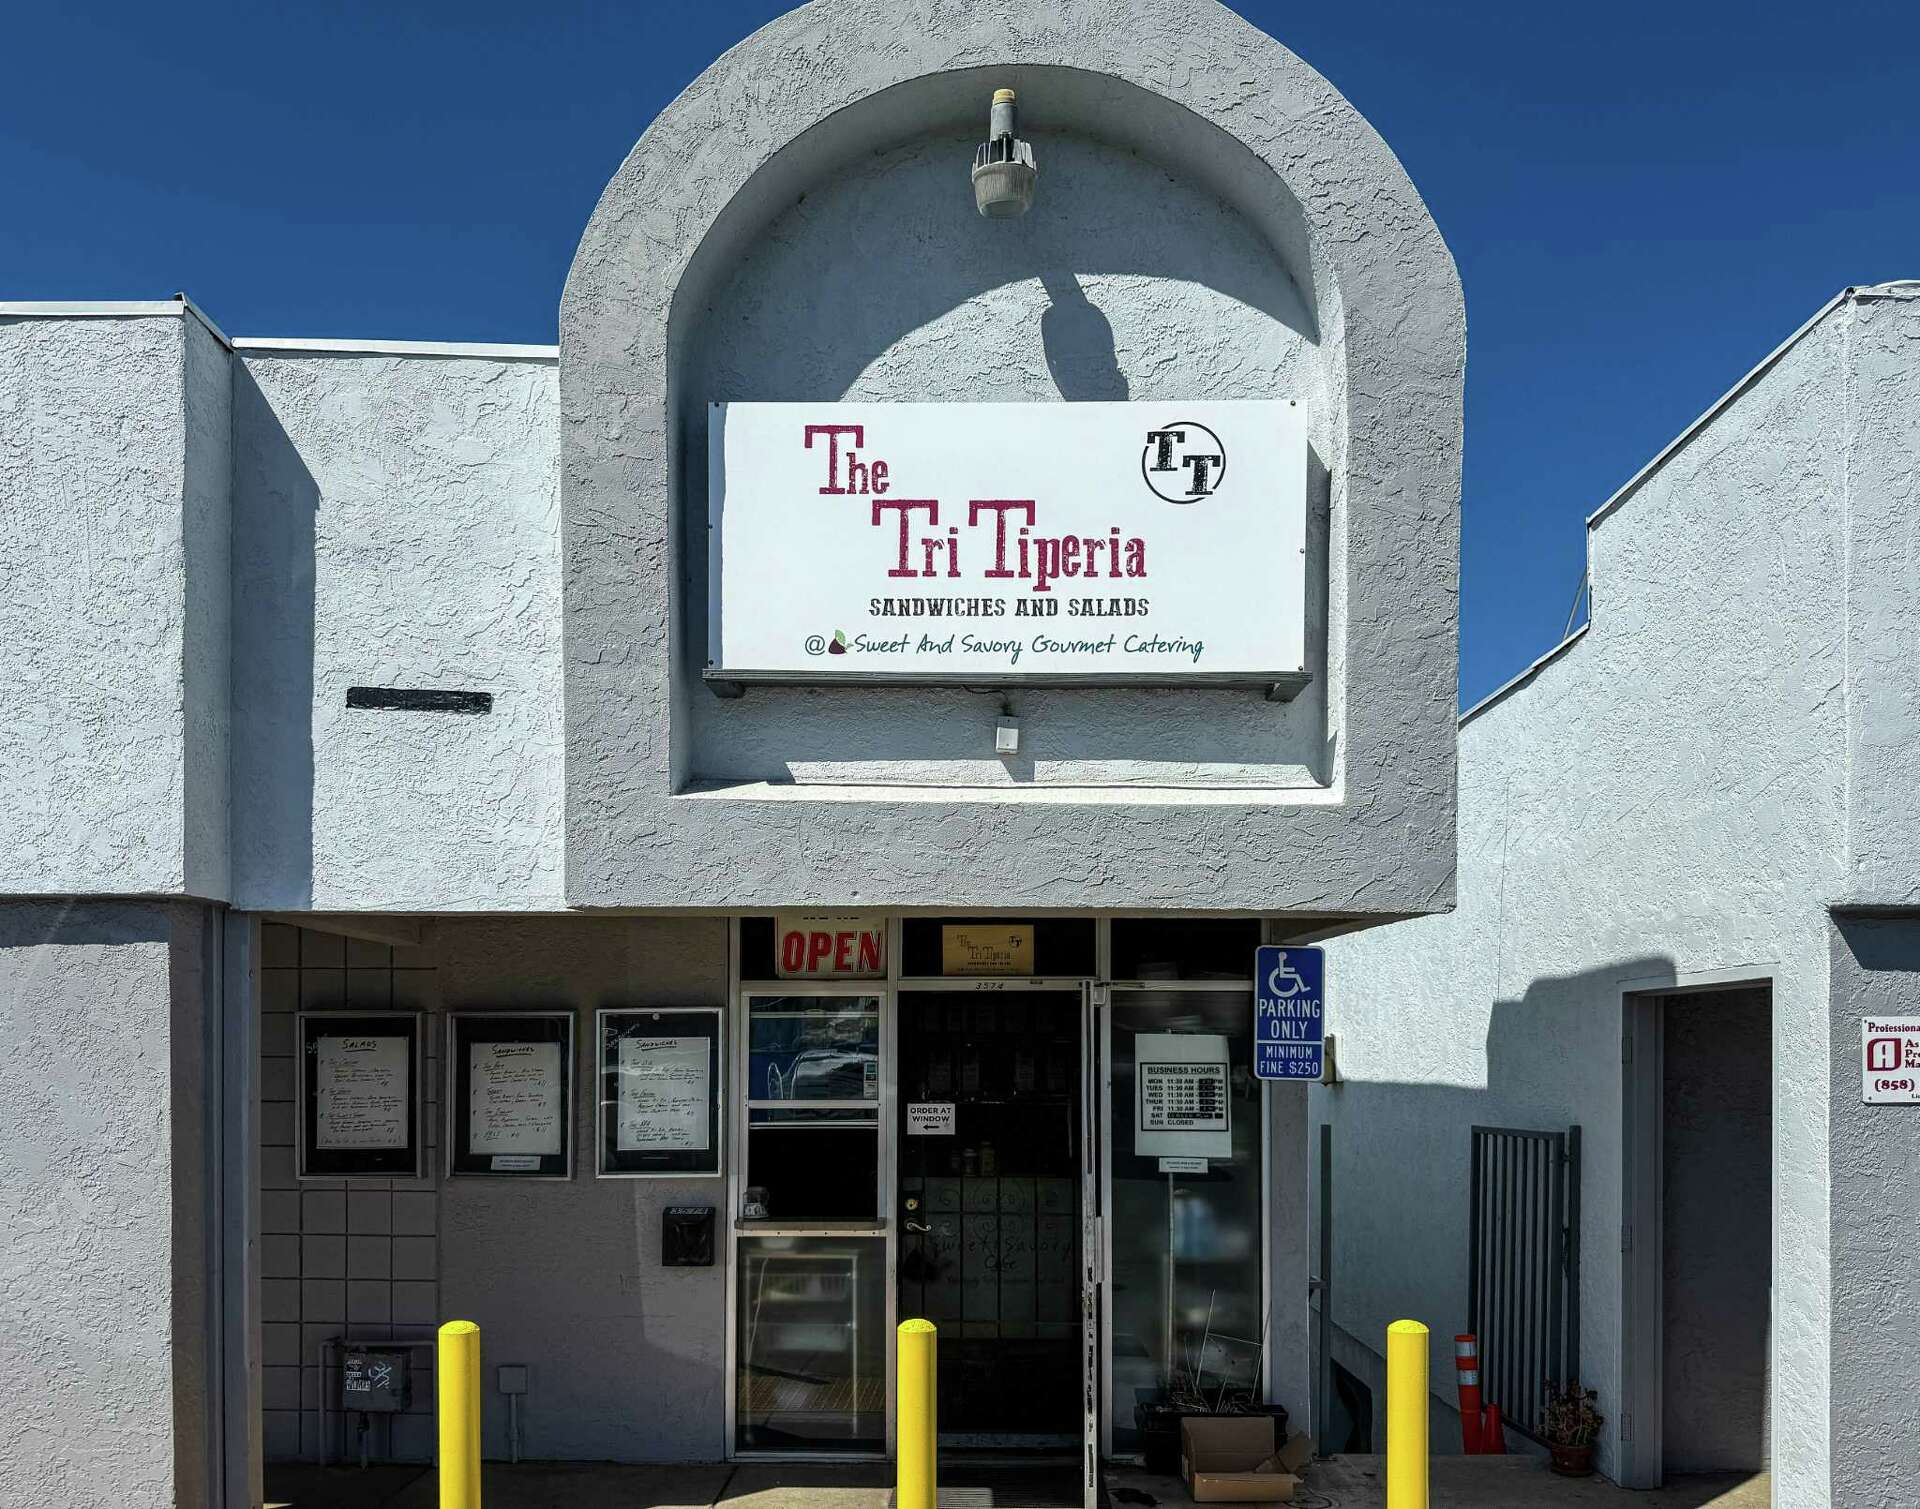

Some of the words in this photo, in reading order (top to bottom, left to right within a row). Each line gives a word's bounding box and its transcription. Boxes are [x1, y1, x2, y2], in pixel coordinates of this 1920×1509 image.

[804, 424, 889, 495] The
[871, 499, 962, 578] Tri
[968, 499, 1147, 592] Tiperia
[868, 598, 1006, 617] SANDWICHES
[1015, 598, 1059, 617] AND
[1067, 598, 1151, 617] SALADS
[804, 634, 826, 657] @
[853, 633, 910, 654] Sweet
[916, 634, 954, 654] And
[961, 634, 1024, 665] Savory
[1032, 634, 1117, 655] Gourmet
[1124, 634, 1206, 664] Catering
[783, 931, 881, 972] OPEN
[1259, 998, 1321, 1018] PARKING
[1270, 1020, 1308, 1040] ONLY
[1266, 1046, 1313, 1059] MINIMUM
[1147, 1066, 1189, 1075] BUSINESS
[1190, 1066, 1221, 1075] HOURS
[1260, 1061, 1284, 1074] FINE
[1289, 1061, 1319, 1075] $250
[1874, 1078, 1915, 1092] (858)
